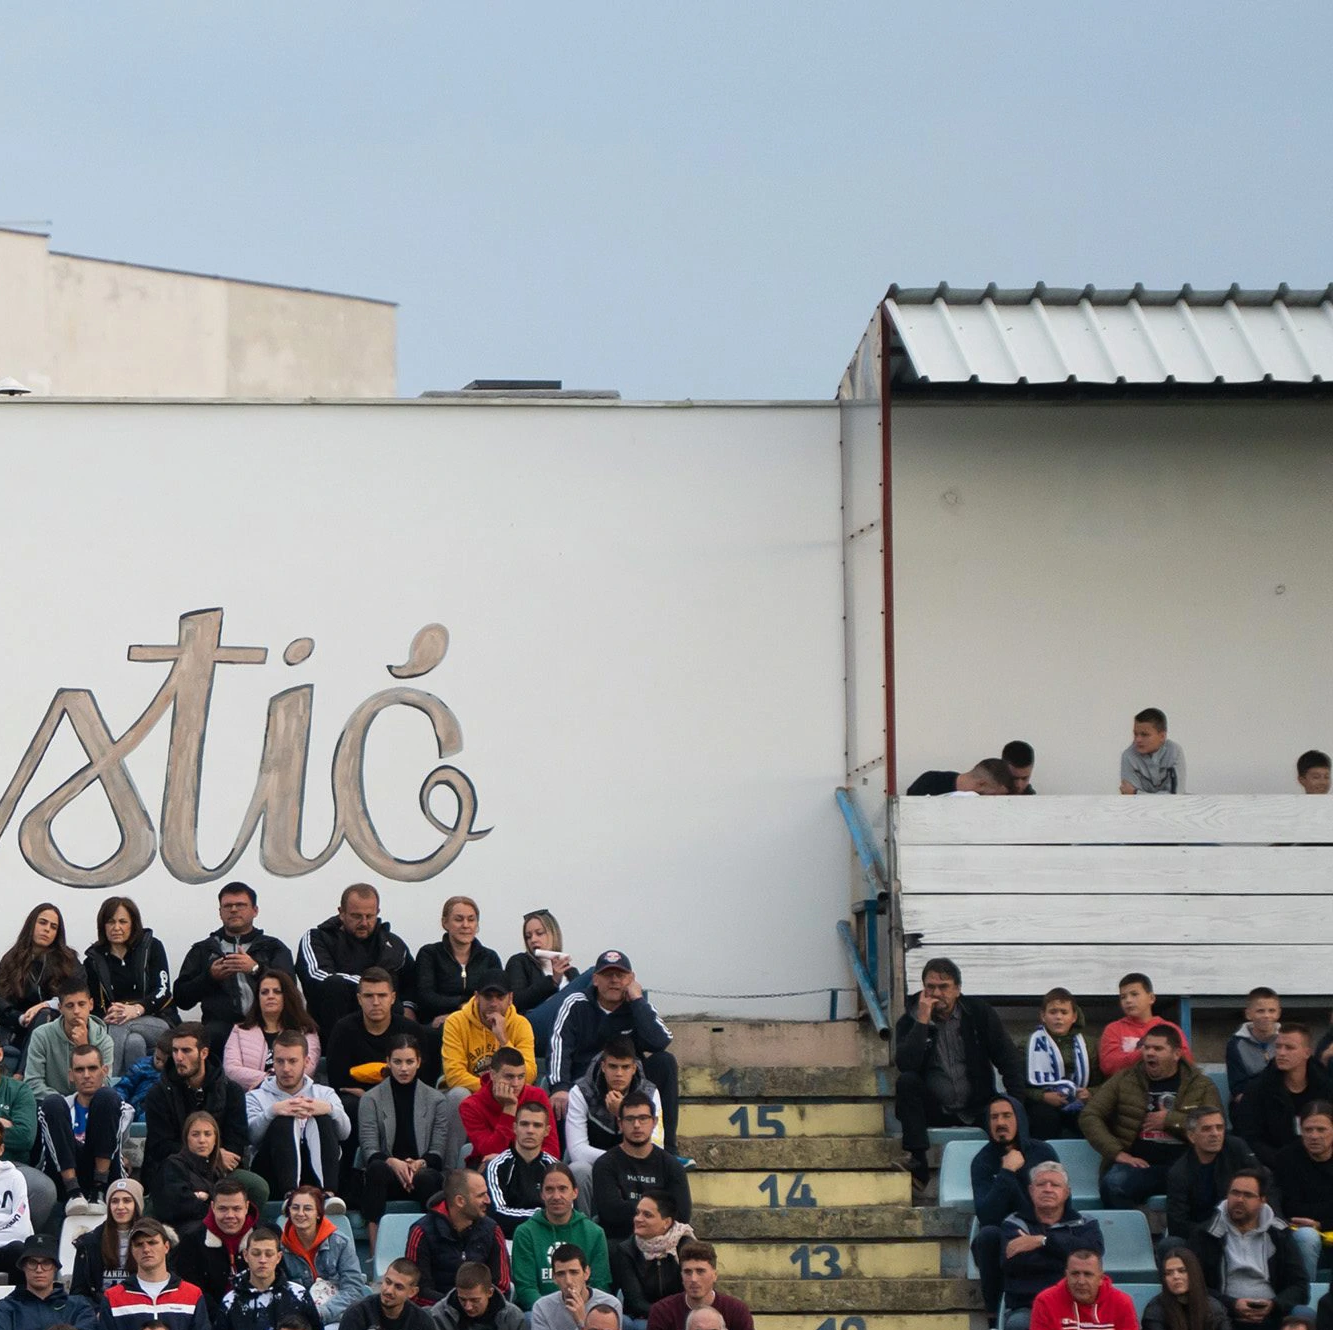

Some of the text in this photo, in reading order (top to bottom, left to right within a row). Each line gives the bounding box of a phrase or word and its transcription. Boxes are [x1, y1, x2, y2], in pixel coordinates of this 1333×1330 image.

[730, 1105, 785, 1139] 15
[758, 1174, 817, 1209] 14
[789, 1244, 842, 1280] 13
